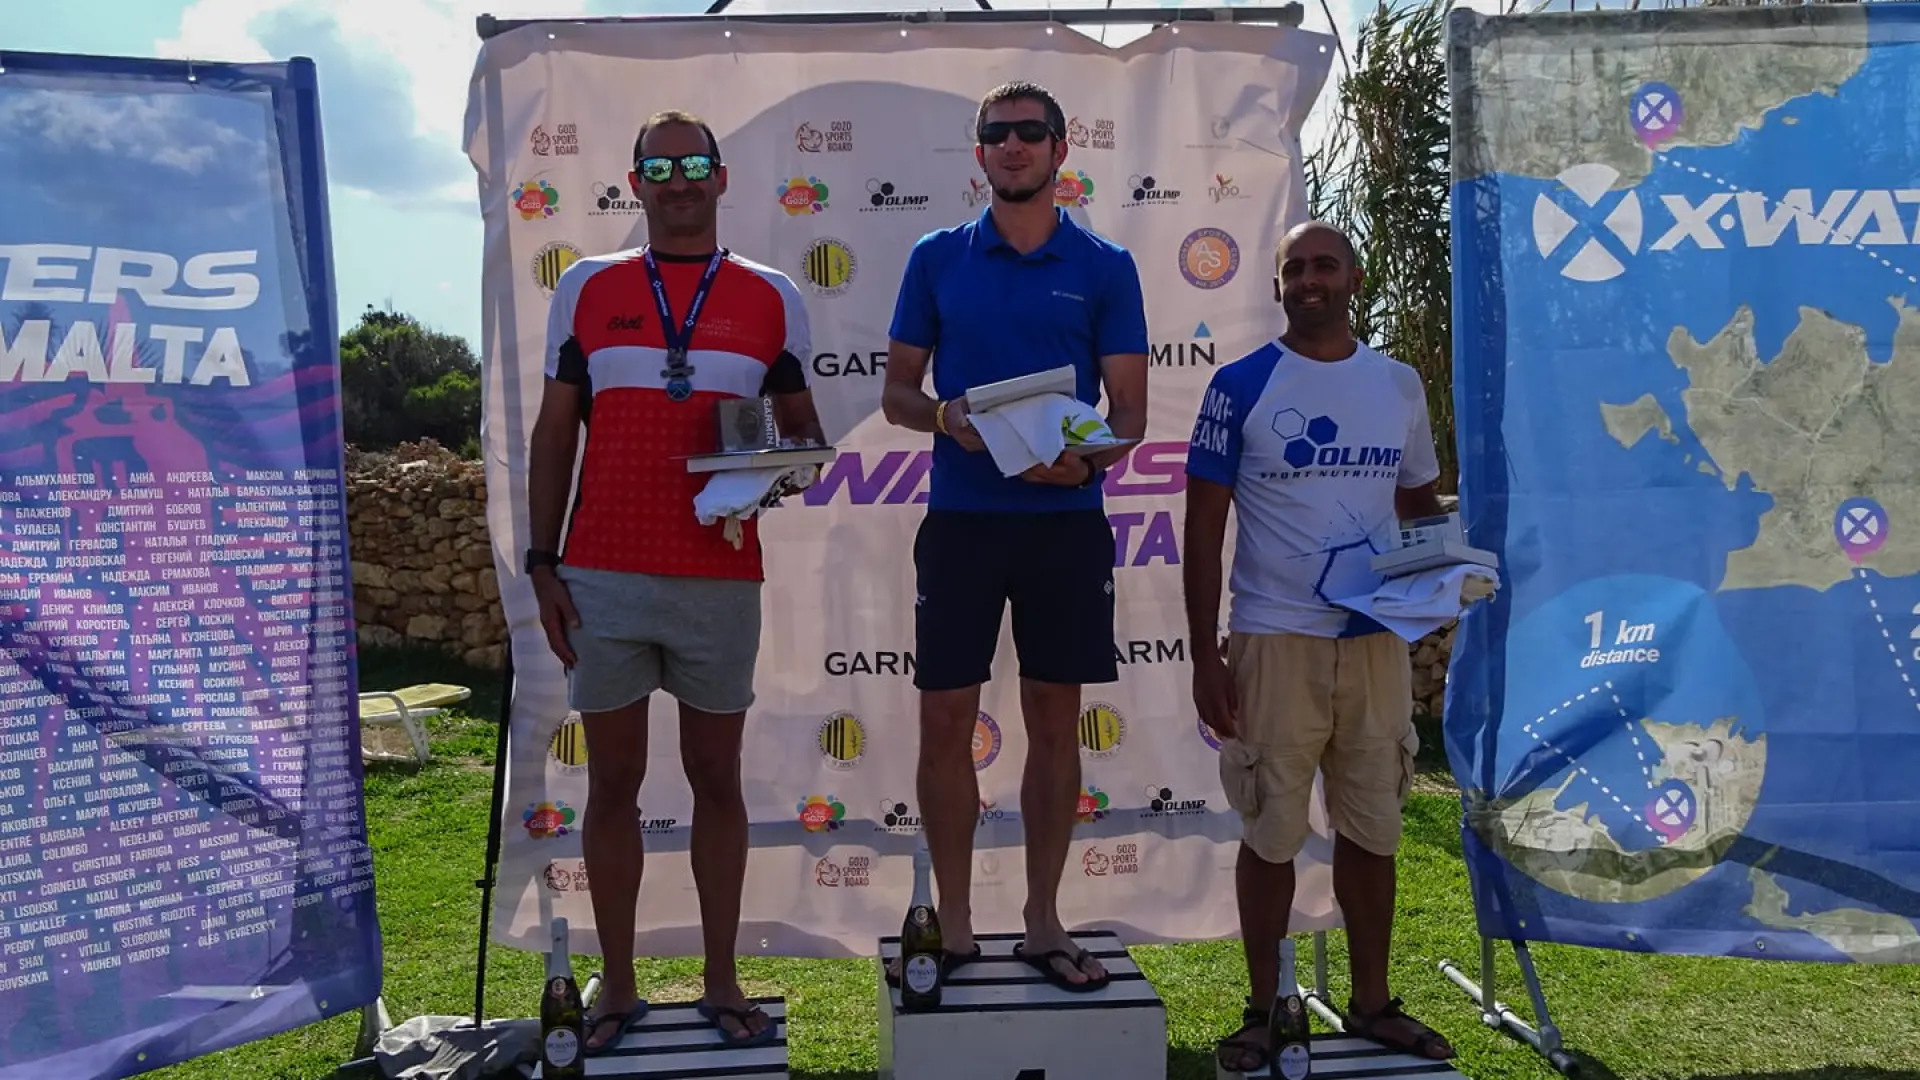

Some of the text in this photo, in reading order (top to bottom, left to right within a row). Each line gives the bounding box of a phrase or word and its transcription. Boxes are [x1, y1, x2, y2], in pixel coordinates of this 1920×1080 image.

[558, 124, 577, 134] GOZO
[831, 121, 852, 132] GOZO
[1096, 120, 1114, 129] GOZO
[552, 135, 578, 145] SPORTS
[825, 132, 852, 142] SPORTS
[1091, 130, 1115, 140] SPORTS
[1093, 140, 1115, 149] BOARD
[555, 146, 578, 155] BOARD
[828, 142, 852, 151] BOARD
[885, 196, 928, 205] OLIMP
[1146, 190, 1180, 199] OLIMP
[611, 201, 645, 209] OLIM
[1149, 342, 1216, 367] MIN
[813, 352, 888, 377] GAR
[764, 398, 774, 445] GARMIN
[1192, 419, 1229, 455] EAM
[1318, 447, 1402, 467] OLIMP
[15, 471, 284, 486] АЛЬМУХАМЕТОВ АННА АНДРЕЕВА МАКСИМ
[1261, 470, 1312, 479] SPORT
[48, 486, 230, 501] АЛЕКСАНДРУ БАЛМУШ НАТАЛЬЯ
[16, 507, 71, 518] БЛАЖЕНОВ
[108, 503, 153, 517] ДМИТРИЙ
[166, 503, 201, 514] БОБРОВ
[236, 501, 287, 513] ВАЛЕНТИНА
[15, 524, 60, 535] БУЛАЕВА
[96, 521, 156, 533] КОНСТАНТИН
[168, 519, 206, 531] БУШУЕВ
[238, 516, 288, 529] АЛЕКСАНДР
[12, 530, 297, 553] ДМИТРИЙ НАТАЛЬЯ ГЛАДКИХ АНДРЕЙ
[56, 548, 265, 568] ДРОЗДОВСКАЯ ЕВГЕНИЙ ДРОЗДОВСКИЙ
[28, 563, 284, 584] ЕРЕМИНА НАДЕЖДА ЕРМАКОВА ВЛАДИМИР
[54, 579, 287, 599] ИВАНОВ МАКСИМ ИВАНОВ ИЛЬДАР
[41, 604, 74, 616] ДЕНИС
[83, 604, 123, 615] КЛИМОВ
[152, 598, 195, 612] АЛЕКСЕЙ
[204, 597, 245, 609] КЛОЧКОВ
[272, 594, 303, 605] ВИКТОР
[24, 609, 311, 632] ДМИТРИЙ КОРОСТЕЛЬ СЕРГЕЙ КОСКИН КОНСТАНТИН
[48, 625, 292, 647] КУЗНЕЦОВ ТАТЬЯНА КУЗНЕЦОВА МАРИЯ
[1583, 611, 1656, 651] 1 km
[77, 639, 309, 661] МАЛЫГИН МАРГАРИТА АЛЕКСЕЙ
[1115, 639, 1184, 665] ARM
[1580, 646, 1660, 668] distance
[152, 660, 246, 676] ГУЛЬНАРА МУСИНА
[824, 651, 917, 676] GARM
[158, 671, 300, 690] КСЕНИЯ ОСОКИНА СОФЬЯ
[194, 692, 235, 703] ЯРОСЛАВ
[172, 706, 260, 718] МАРИЯ РОМАНОВА
[67, 721, 226, 737] ЯНА СЕРГЕЕВА
[0, 748, 46, 764] СОЛНЦЕВ
[72, 740, 98, 753] АННА
[209, 735, 259, 745] СУГРОБОВА
[48, 750, 146, 774] ВАСИЛИЙ УЛЬЯНОВ
[53, 768, 138, 791] КСЕНИЯ ЧАЧИНА
[43, 783, 150, 809] ОЛЬГА ШАПОВАЛОВА
[1165, 800, 1205, 811] OLIMP
[2, 797, 163, 833] ЯКОВЛЕВ МАРИЯ ЯКУШЕВА
[640, 820, 676, 828] LIMP
[898, 817, 924, 826] OLI
[40, 807, 200, 844] BARBARA ALEXEY BEVETSKIY
[43, 822, 211, 861] COLOMBO NEDELJKO DABOVIC
[1117, 844, 1137, 852] GOZO
[73, 833, 239, 873] CHRISTIAN FARRUGIA MASSIMO
[849, 857, 869, 866] GOZO
[1111, 854, 1137, 864] SPORTS
[41, 846, 248, 896] CORNELIA GSENGER PIA HESS GANNA
[573, 872, 588, 881] SPO
[843, 868, 869, 876] SPORTS
[1113, 864, 1138, 874] BOARD
[14, 857, 271, 918] LISOUSKI NATALI LUCHKO MATVEY LUTSENKO
[575, 882, 589, 891] BOA
[845, 877, 869, 887] BOARD
[20, 870, 283, 935] MICALLEF MARINA STEPHEN MUSCAT
[113, 905, 196, 933] KRISTINE RUDZITE
[20, 906, 265, 970] SHAY SLOBODIAN SPANIA
[81, 933, 219, 973] YAUHENI YAROTSKI OLEG
